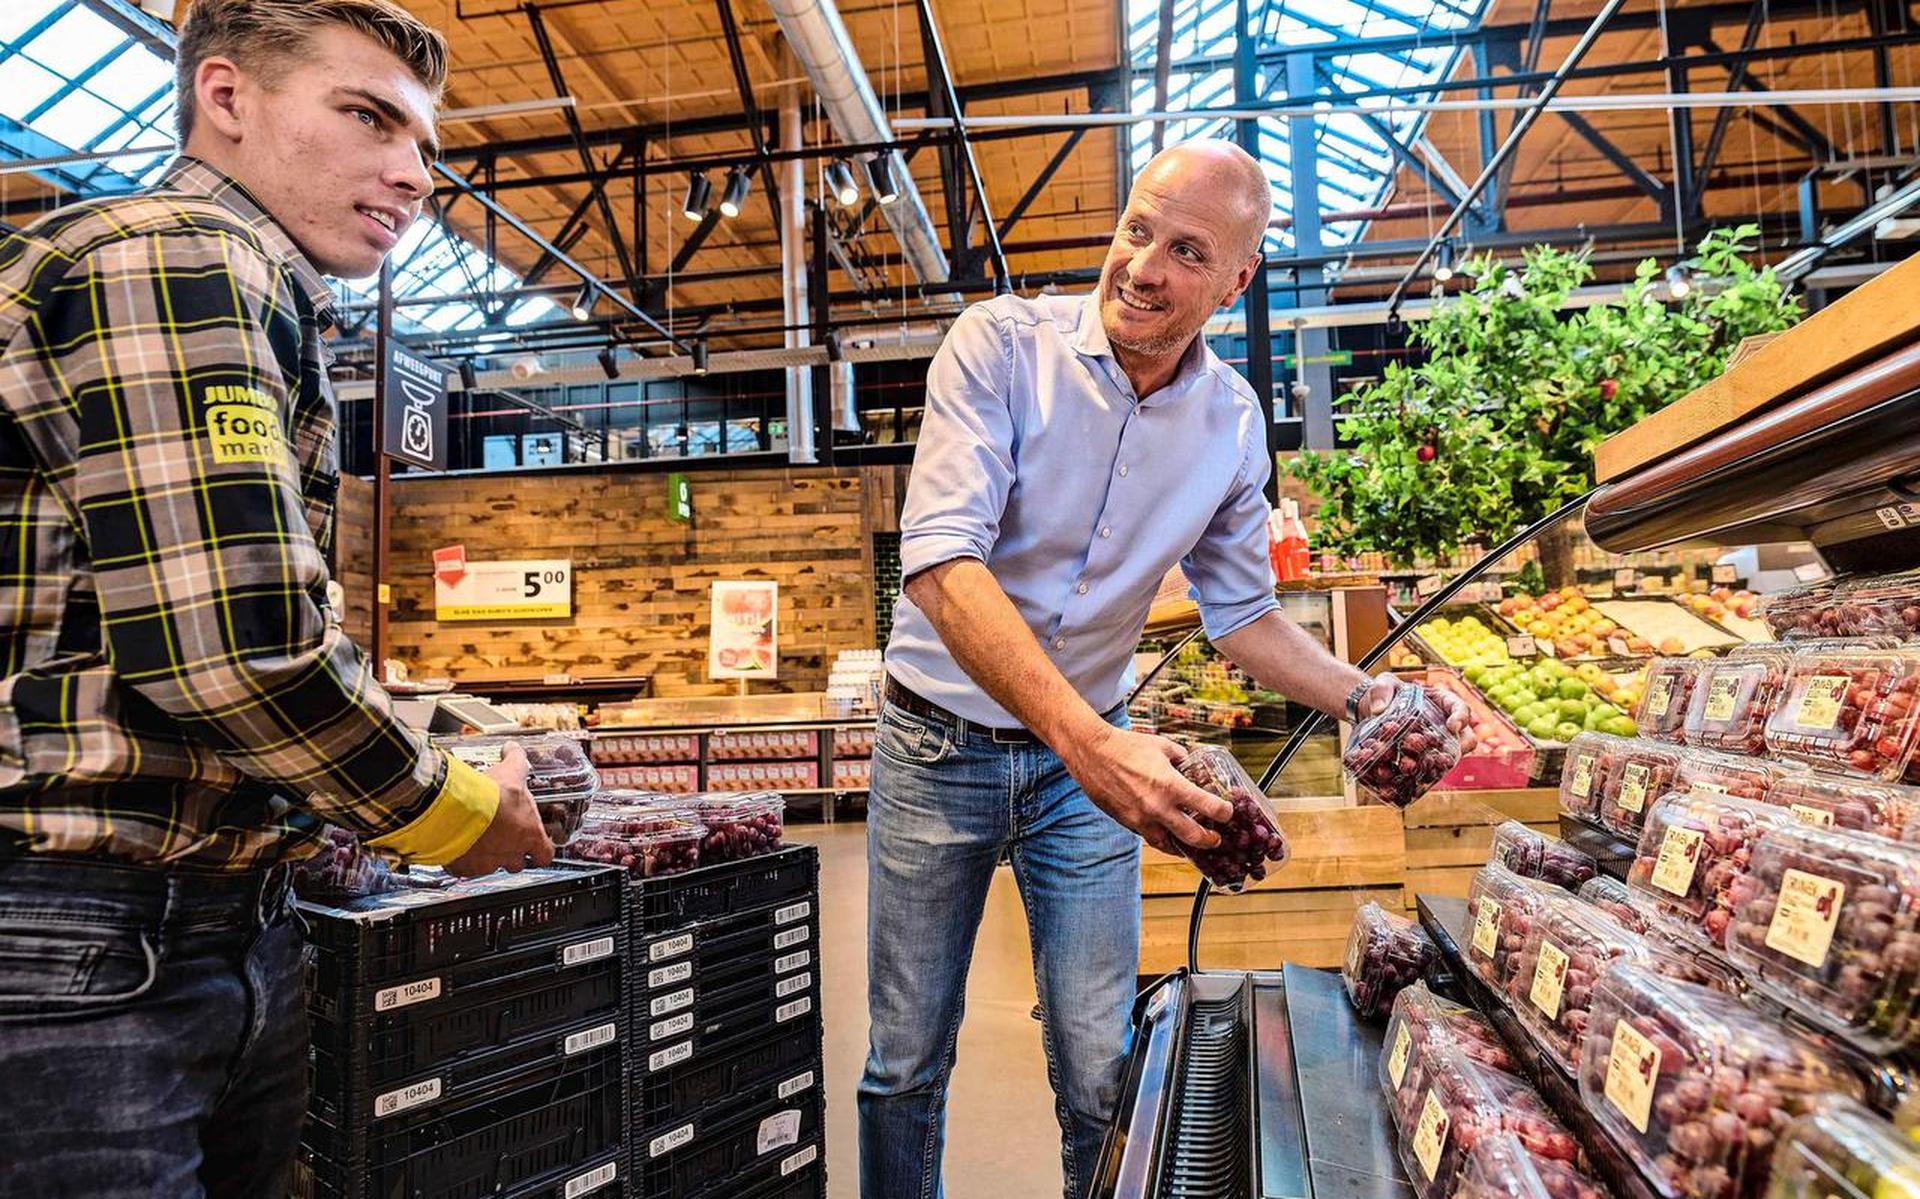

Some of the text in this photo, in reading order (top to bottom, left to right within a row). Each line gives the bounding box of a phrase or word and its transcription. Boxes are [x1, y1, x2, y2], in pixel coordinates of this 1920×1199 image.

[203, 385, 279, 412] JUMBO
[668, 937, 688, 950] 10404
[667, 964, 688, 978] 10404
[404, 981, 433, 998] 10404
[670, 991, 690, 1004] 10404
[668, 1015, 688, 1029] 10404
[668, 1043, 688, 1058] 10404
[404, 1083, 434, 1100] 10404
[669, 1127, 689, 1143] 10404
